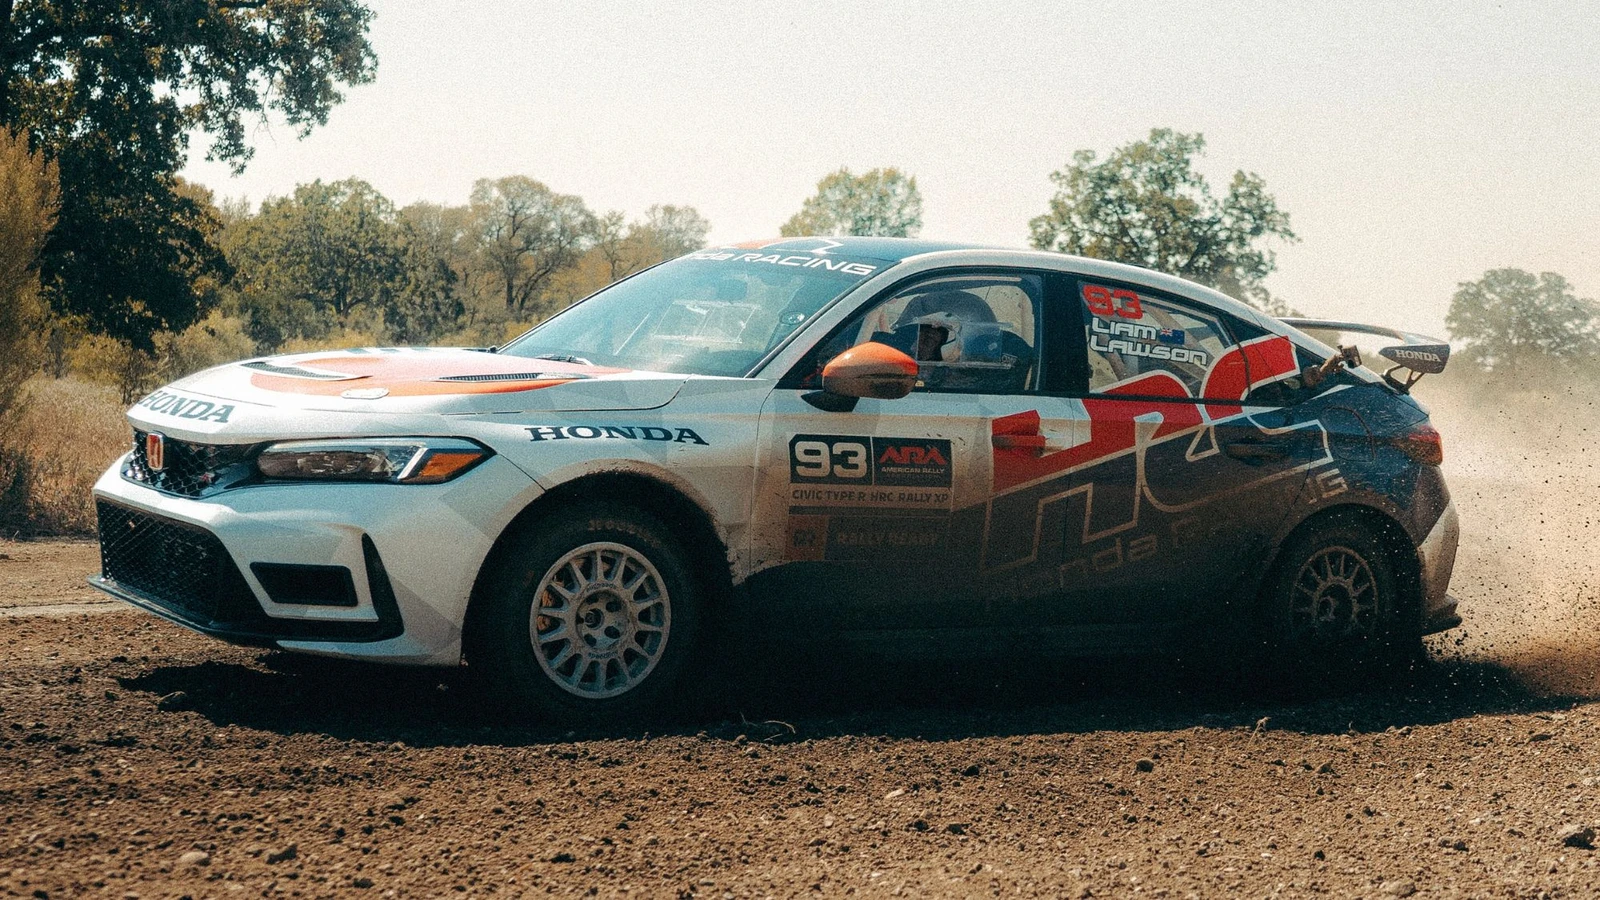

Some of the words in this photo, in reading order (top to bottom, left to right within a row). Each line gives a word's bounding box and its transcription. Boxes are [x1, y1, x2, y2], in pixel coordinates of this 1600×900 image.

[733, 253, 877, 275] RACING
[1083, 284, 1143, 320] 93
[1092, 317, 1157, 340] LIAM
[1090, 335, 1207, 365] LAWSON
[1395, 350, 1441, 362] HONDA
[138, 391, 235, 423] HONDA
[524, 426, 710, 446] HONDA
[795, 441, 867, 478] 93
[880, 446, 947, 466] ARA
[792, 489, 822, 500] CIVIC
[826, 490, 855, 501] TYPE
[857, 491, 866, 501] R
[870, 491, 894, 502] HRC
[899, 492, 931, 503] RALLY
[934, 493, 948, 503] XP
